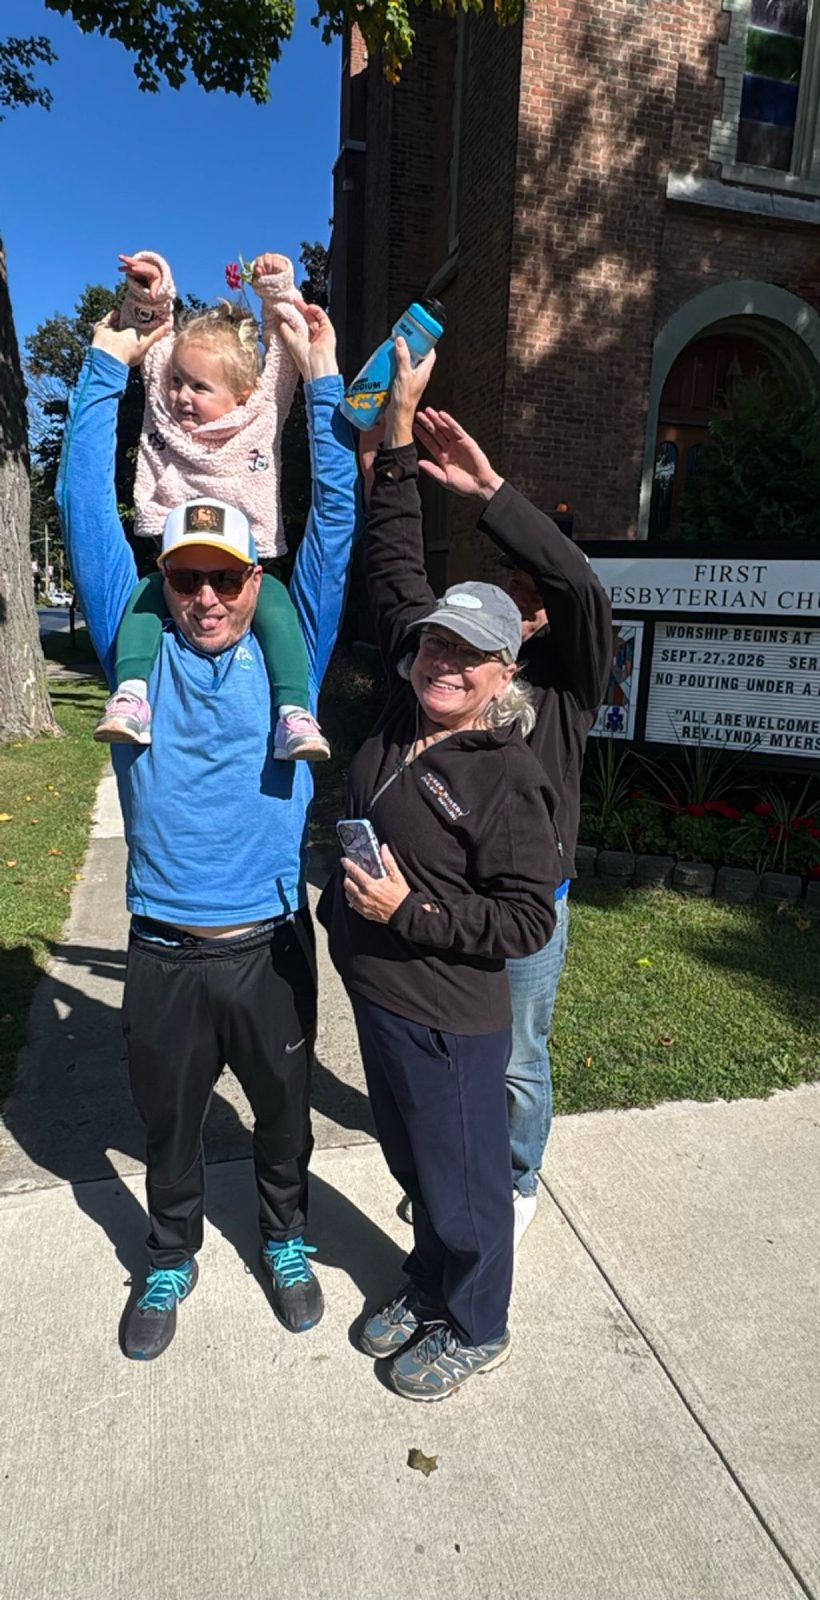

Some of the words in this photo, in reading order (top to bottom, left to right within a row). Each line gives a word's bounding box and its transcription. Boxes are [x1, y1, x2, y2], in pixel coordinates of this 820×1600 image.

[694, 564, 768, 584] FIRST
[610, 586, 767, 608] ESBYTERIAN
[777, 591, 820, 610] CH
[665, 625, 728, 640] WORSHIP
[733, 628, 787, 643] BEGINS
[792, 632, 812, 645] AT
[788, 656, 820, 671] SER
[655, 672, 673, 685] NO
[678, 674, 739, 690] POUTING
[746, 679, 794, 694] UNDER
[802, 682, 811, 695] A
[714, 712, 742, 727] ARE
[745, 715, 820, 733] WELCOME
[770, 733, 820, 751] MYERS
